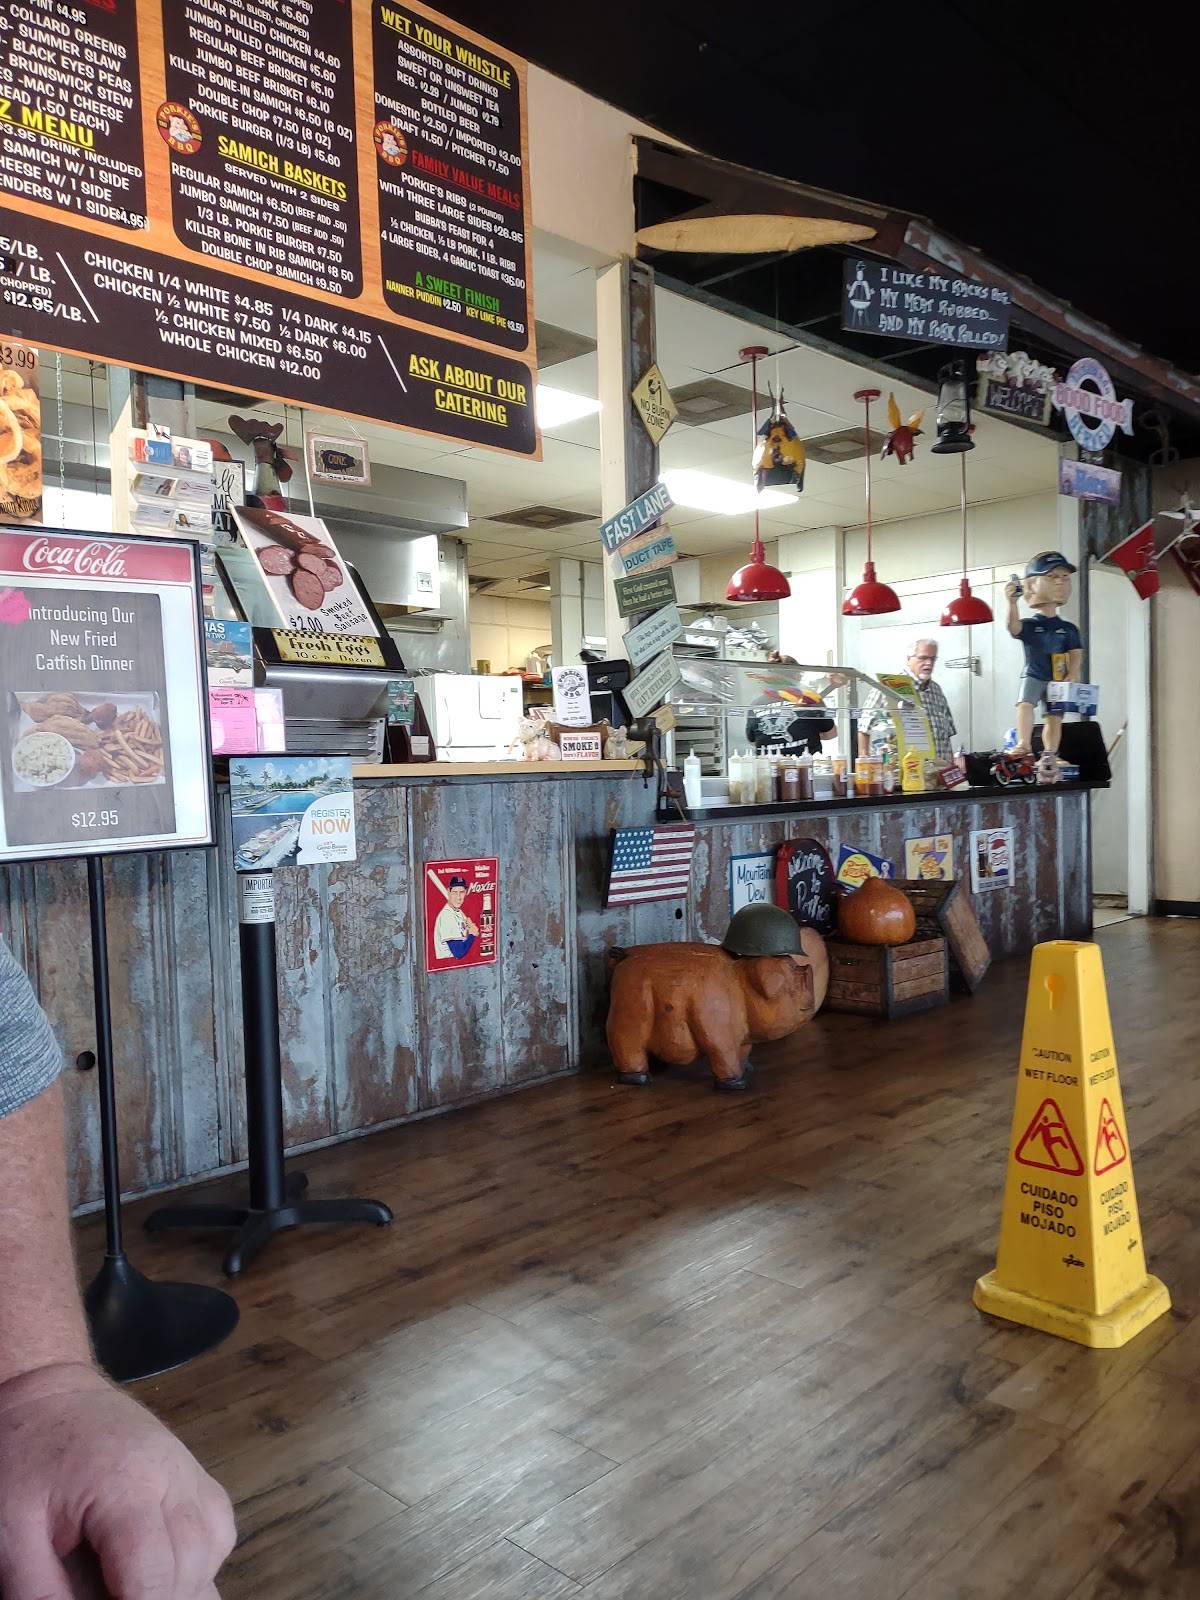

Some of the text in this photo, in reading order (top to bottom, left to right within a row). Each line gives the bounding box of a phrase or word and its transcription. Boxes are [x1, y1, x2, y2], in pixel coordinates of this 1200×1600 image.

[10, 3, 127, 60] COLLARD GREENS
[19, 25, 121, 73] SUMMER SLAW
[185, 7, 222, 33] JUMBO
[225, 24, 263, 51] PULLED
[265, 40, 308, 72] CHICKEN
[381, 6, 511, 85] WET YOUR WHISTLE
[8, 53, 133, 109] BRUNSWICK STEW
[13, 38, 133, 93] BLACK EYES PEAS
[189, 26, 335, 100] REGULAR BEEF BRISKET $5.10
[398, 40, 499, 98] ASSORTED SOFT DRINKS
[397, 55, 500, 113] SWEET OR UNSWEET TEA
[22, 106, 94, 147] MENU
[188, 98, 229, 124] PORKIE
[231, 115, 273, 141] BURGER
[296, 142, 312, 159] LB)
[3, 138, 130, 191] SAMICH W/ 1 SIDE
[218, 135, 347, 200] SAMICH BASKETS
[412, 151, 521, 206] FAMILY VALUE MEALS
[225, 163, 340, 212] SERVED WITH 2 SIDES
[379, 178, 404, 198] WITH
[406, 189, 435, 210] THREE
[437, 203, 466, 222] LARGE
[467, 215, 492, 233] SIDES
[401, 172, 467, 208] PORKIE'S RIBS
[201, 241, 342, 294] DOUBLE CHOP SAMICH $9.50
[880, 267, 889, 282] I
[892, 270, 926, 289] LIKE
[928, 275, 950, 292] MY
[951, 279, 989, 299] RACKS
[84, 251, 372, 345] CHICKEN 1/4 WHITE $4.85 1/4 DARK $4.15
[415, 271, 501, 312] A SWEET FINISH
[879, 288, 900, 308] MY
[904, 293, 935, 314] MEAT
[173, 313, 323, 364] CHICKEN MIXED $6.50
[878, 313, 904, 332] AND
[907, 316, 926, 335] MY
[928, 319, 956, 342] PORK
[158, 328, 321, 381] WHOLE CHICKEN $12.00
[409, 353, 527, 403] ASK ABOUT OUR
[434, 388, 508, 424] CATERING
[604, 485, 671, 549] FAST LANE
[22, 537, 129, 577] Coca-Cola
[624, 536, 675, 570] DUCT TAPE
[111, 606, 135, 624] Our
[289, 614, 324, 633] $2.00
[320, 597, 353, 617] Smoked
[335, 612, 368, 632] Sausage
[50, 629, 118, 647] New Fried
[205, 621, 226, 634] AS
[36, 653, 135, 672] Catfish Dinner
[289, 637, 371, 657] Fresh Eggs
[562, 741, 593, 751] SMOKE
[71, 809, 119, 828] $12.95
[311, 808, 351, 819] REGISTER
[311, 818, 351, 836] NOW
[744, 882, 767, 903] Dew
[1032, 1047, 1073, 1064] CAUTION
[1024, 1067, 1079, 1087] WET FLOOR
[1020, 1181, 1079, 1208] CUIDADO
[1033, 1200, 1065, 1220] PISO
[1100, 1181, 1129, 1206] CUIDADO
[1107, 1199, 1124, 1218] PISO
[1020, 1211, 1077, 1238] MOJADO
[1103, 1210, 1132, 1237] MOJADO
